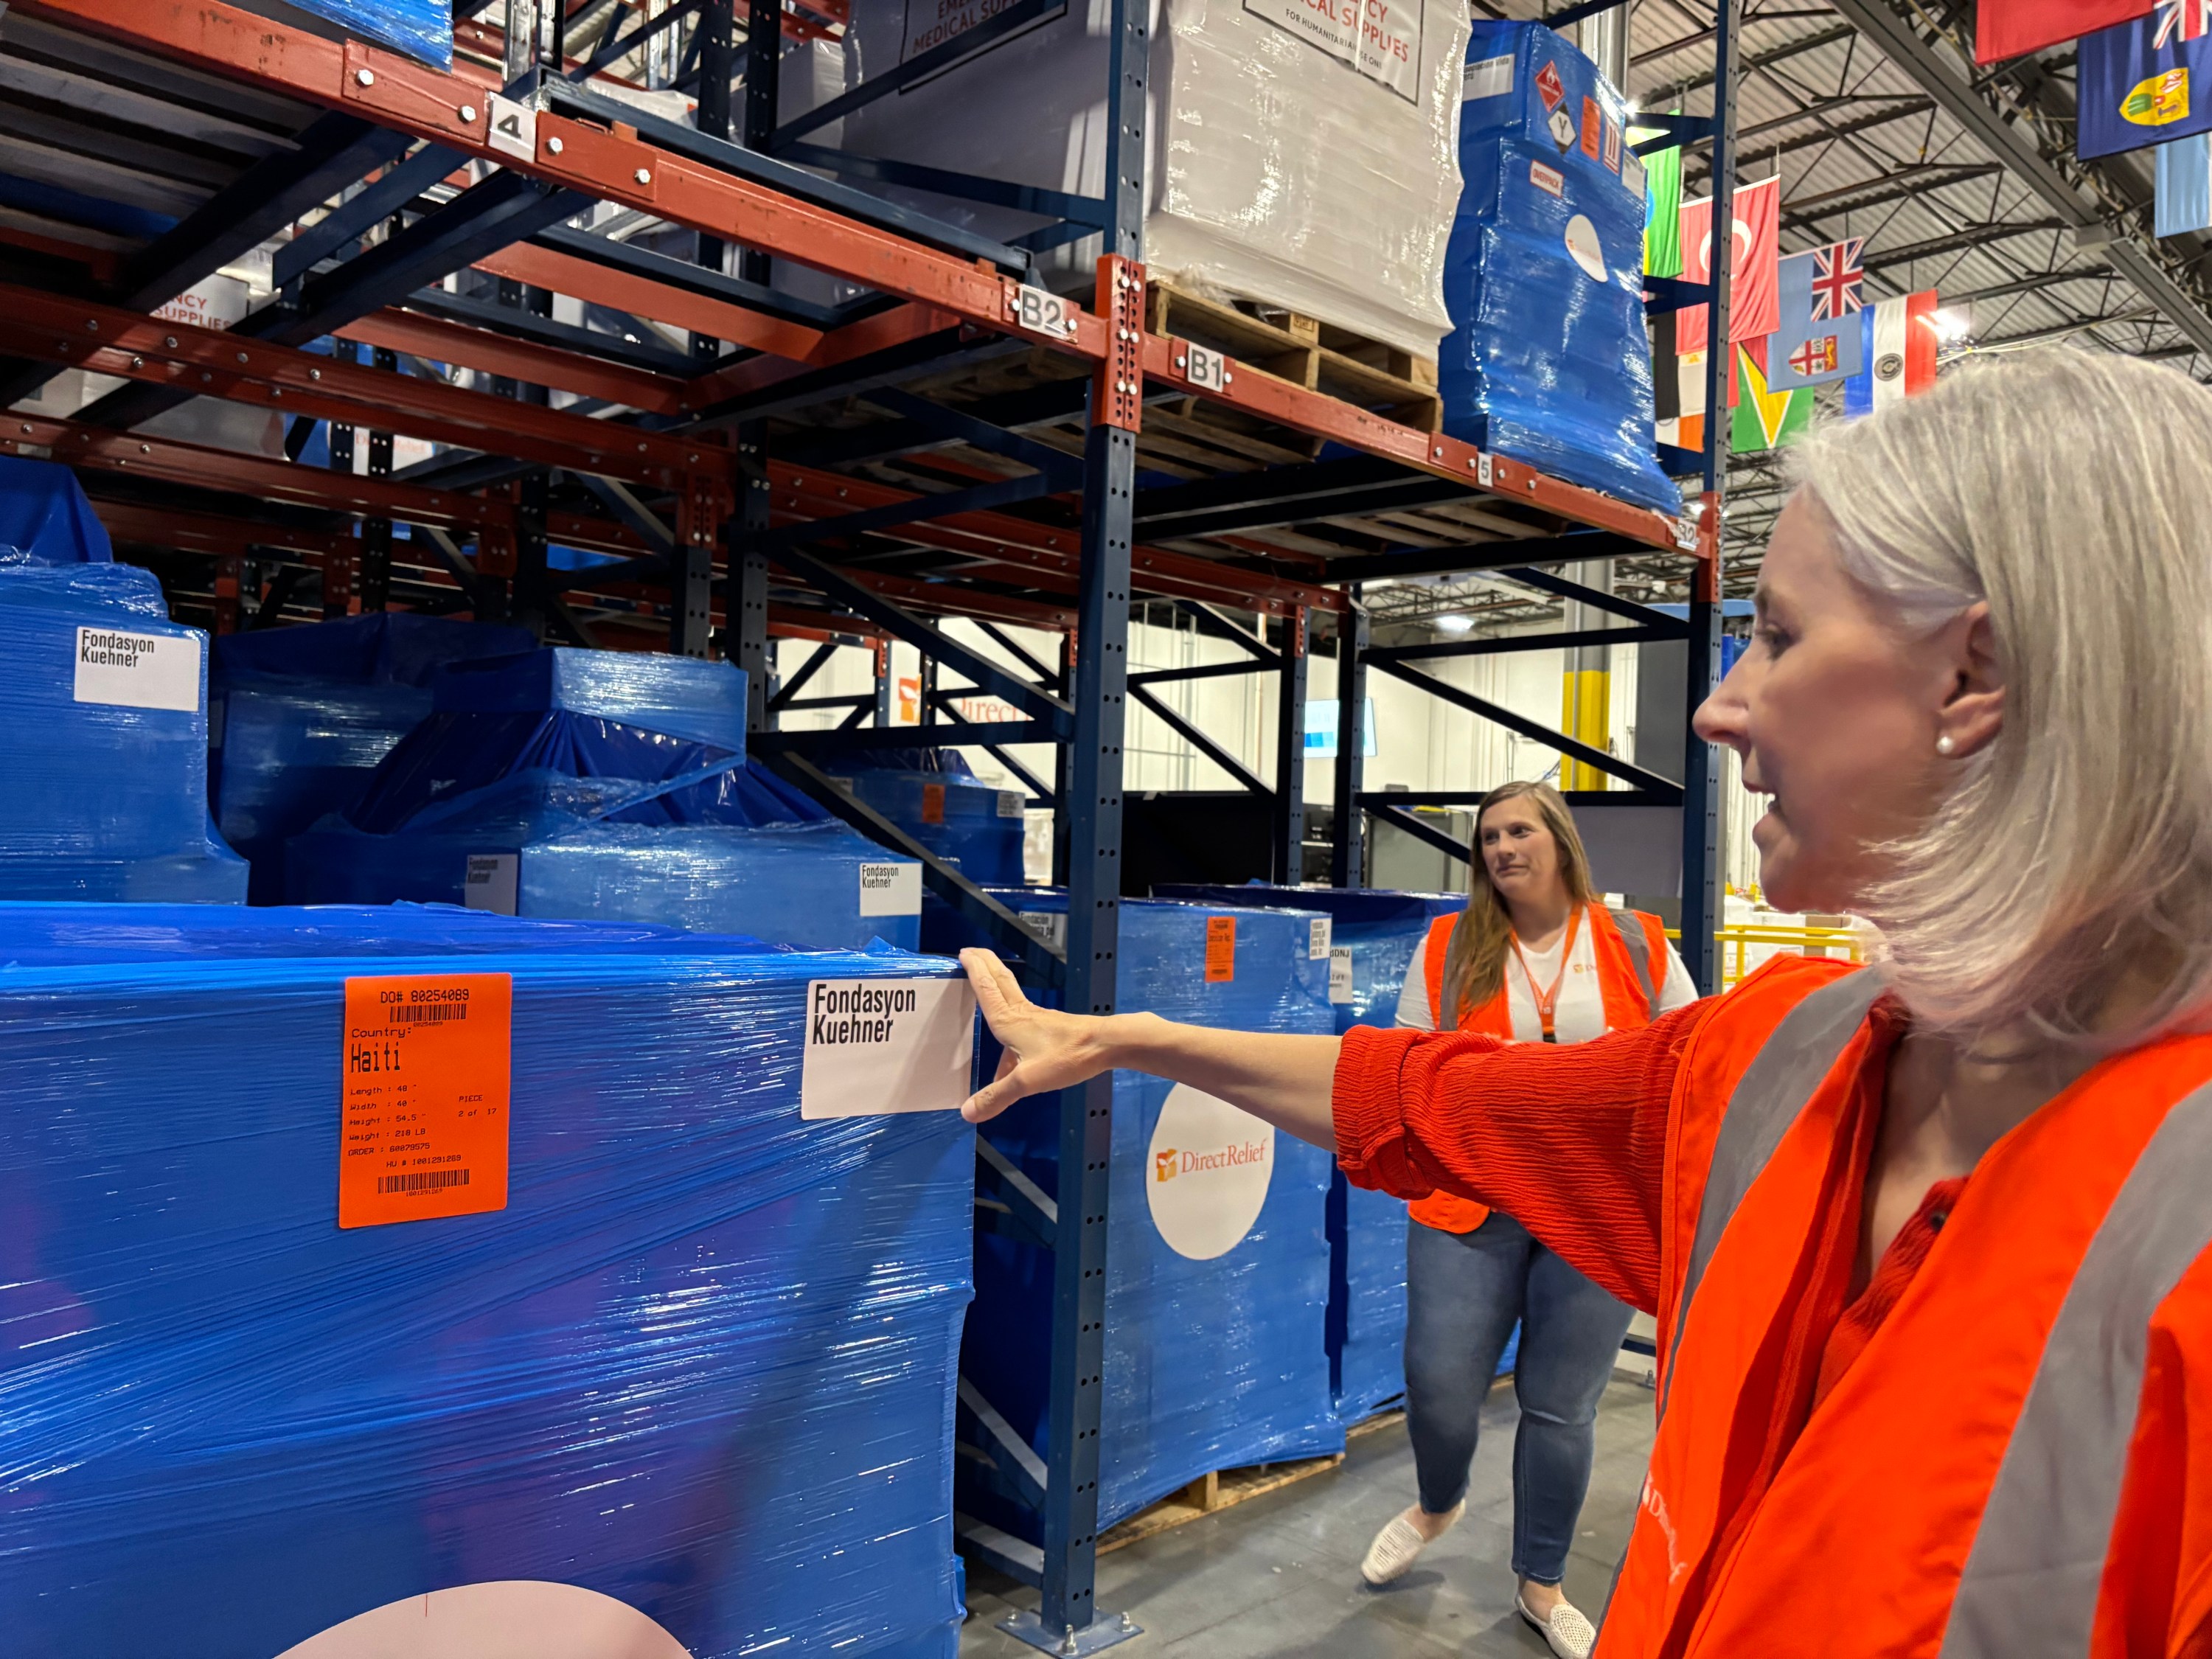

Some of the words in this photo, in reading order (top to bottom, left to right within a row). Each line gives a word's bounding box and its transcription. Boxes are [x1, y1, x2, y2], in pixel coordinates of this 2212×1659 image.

[1286, 9, 1301, 23] FOR
[913, 9, 976, 53] MEDICAL
[1341, 7, 1409, 62] SUPPLIES
[498, 114, 522, 139] 4
[1022, 290, 1065, 336] B2
[1192, 349, 1221, 387] B1
[1481, 460, 1489, 479] 5
[82, 629, 154, 654] Fondasyon
[81, 646, 139, 667] Kuehner
[961, 697, 1018, 722] irec
[862, 865, 899, 879] Fondasyon
[862, 876, 891, 888] Kuehner
[380, 991, 403, 1004] DO#
[411, 989, 469, 1002] 80254089
[814, 984, 916, 1019] Fondasyon
[352, 1027, 411, 1038] Country:
[813, 1014, 894, 1044] Kuehner
[351, 1041, 400, 1073] Haiti
[350, 1087, 382, 1096] Length
[349, 1103, 377, 1111] Width
[349, 1117, 380, 1127] Height
[396, 1114, 417, 1122] 54.5
[349, 1133, 380, 1141] Weight
[415, 1128, 426, 1136] LB
[348, 1147, 375, 1156] ORDER
[389, 1142, 431, 1152] 60079575
